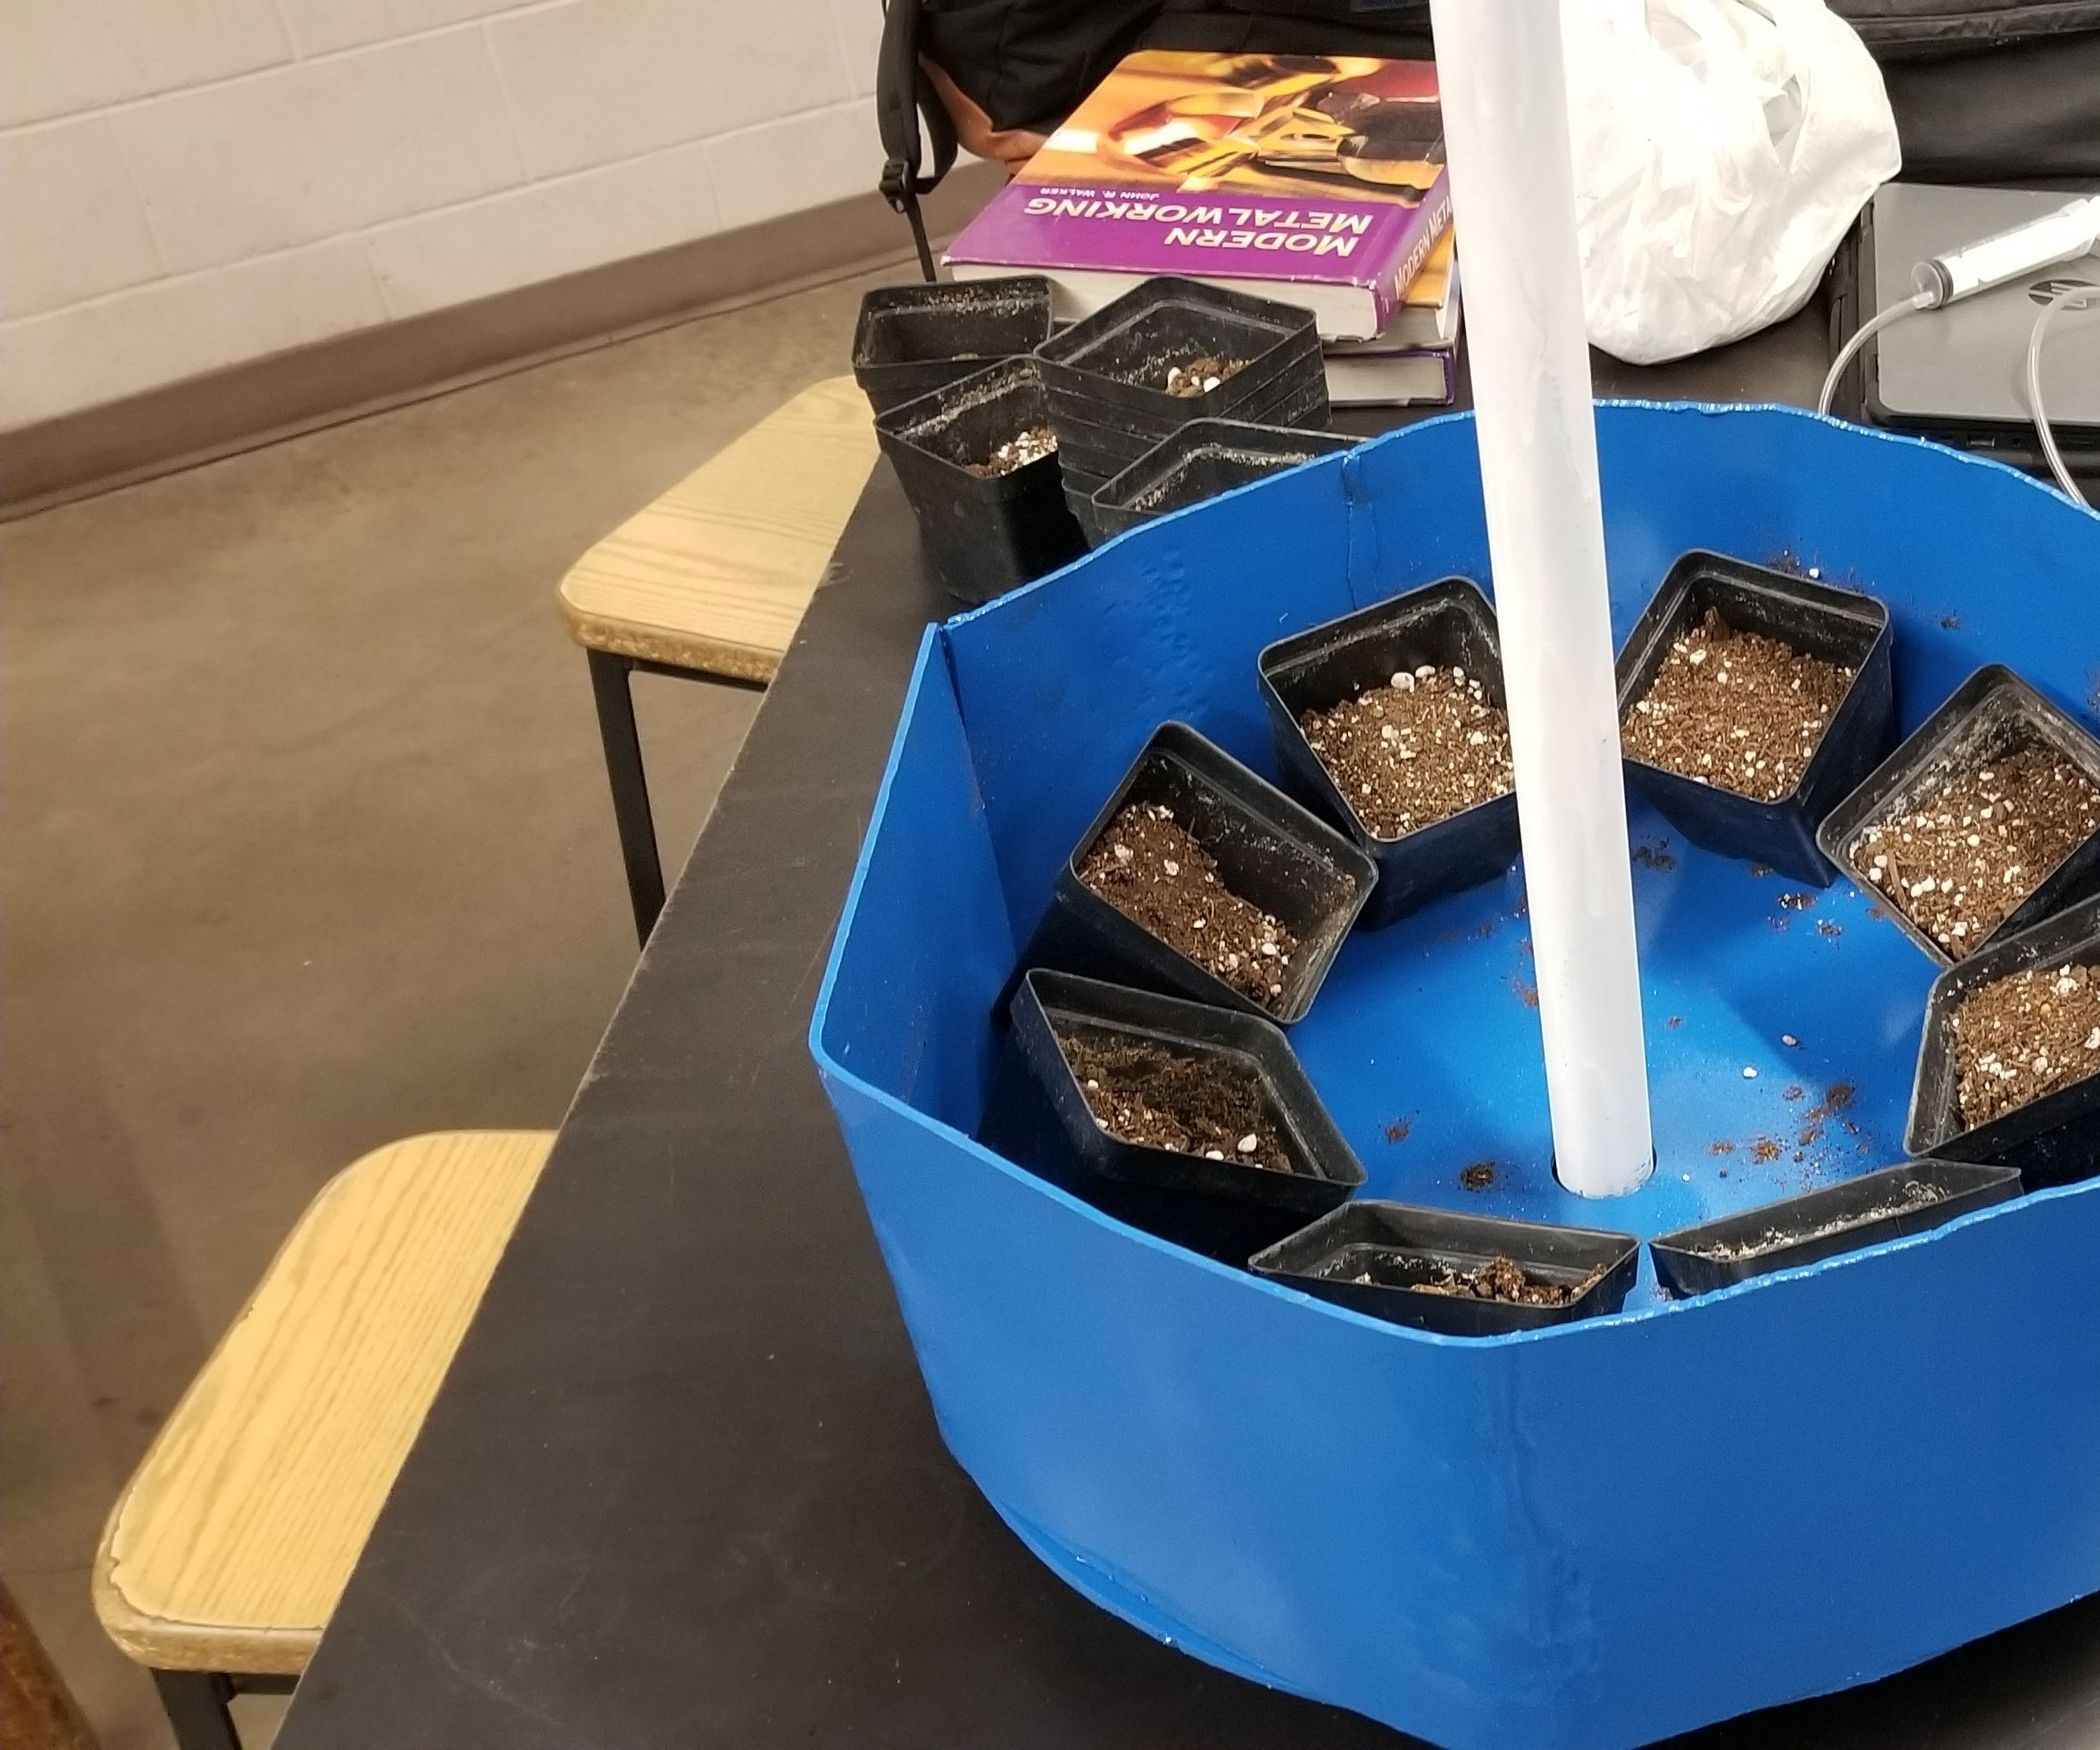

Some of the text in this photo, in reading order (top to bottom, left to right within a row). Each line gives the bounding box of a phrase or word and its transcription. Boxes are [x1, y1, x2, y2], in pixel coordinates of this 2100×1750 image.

[1040, 186, 1096, 198] WALKER
[1119, 191, 1160, 200] JOHN
[1164, 226, 1360, 258] MODERN
[1394, 228, 1430, 301] MODERN
